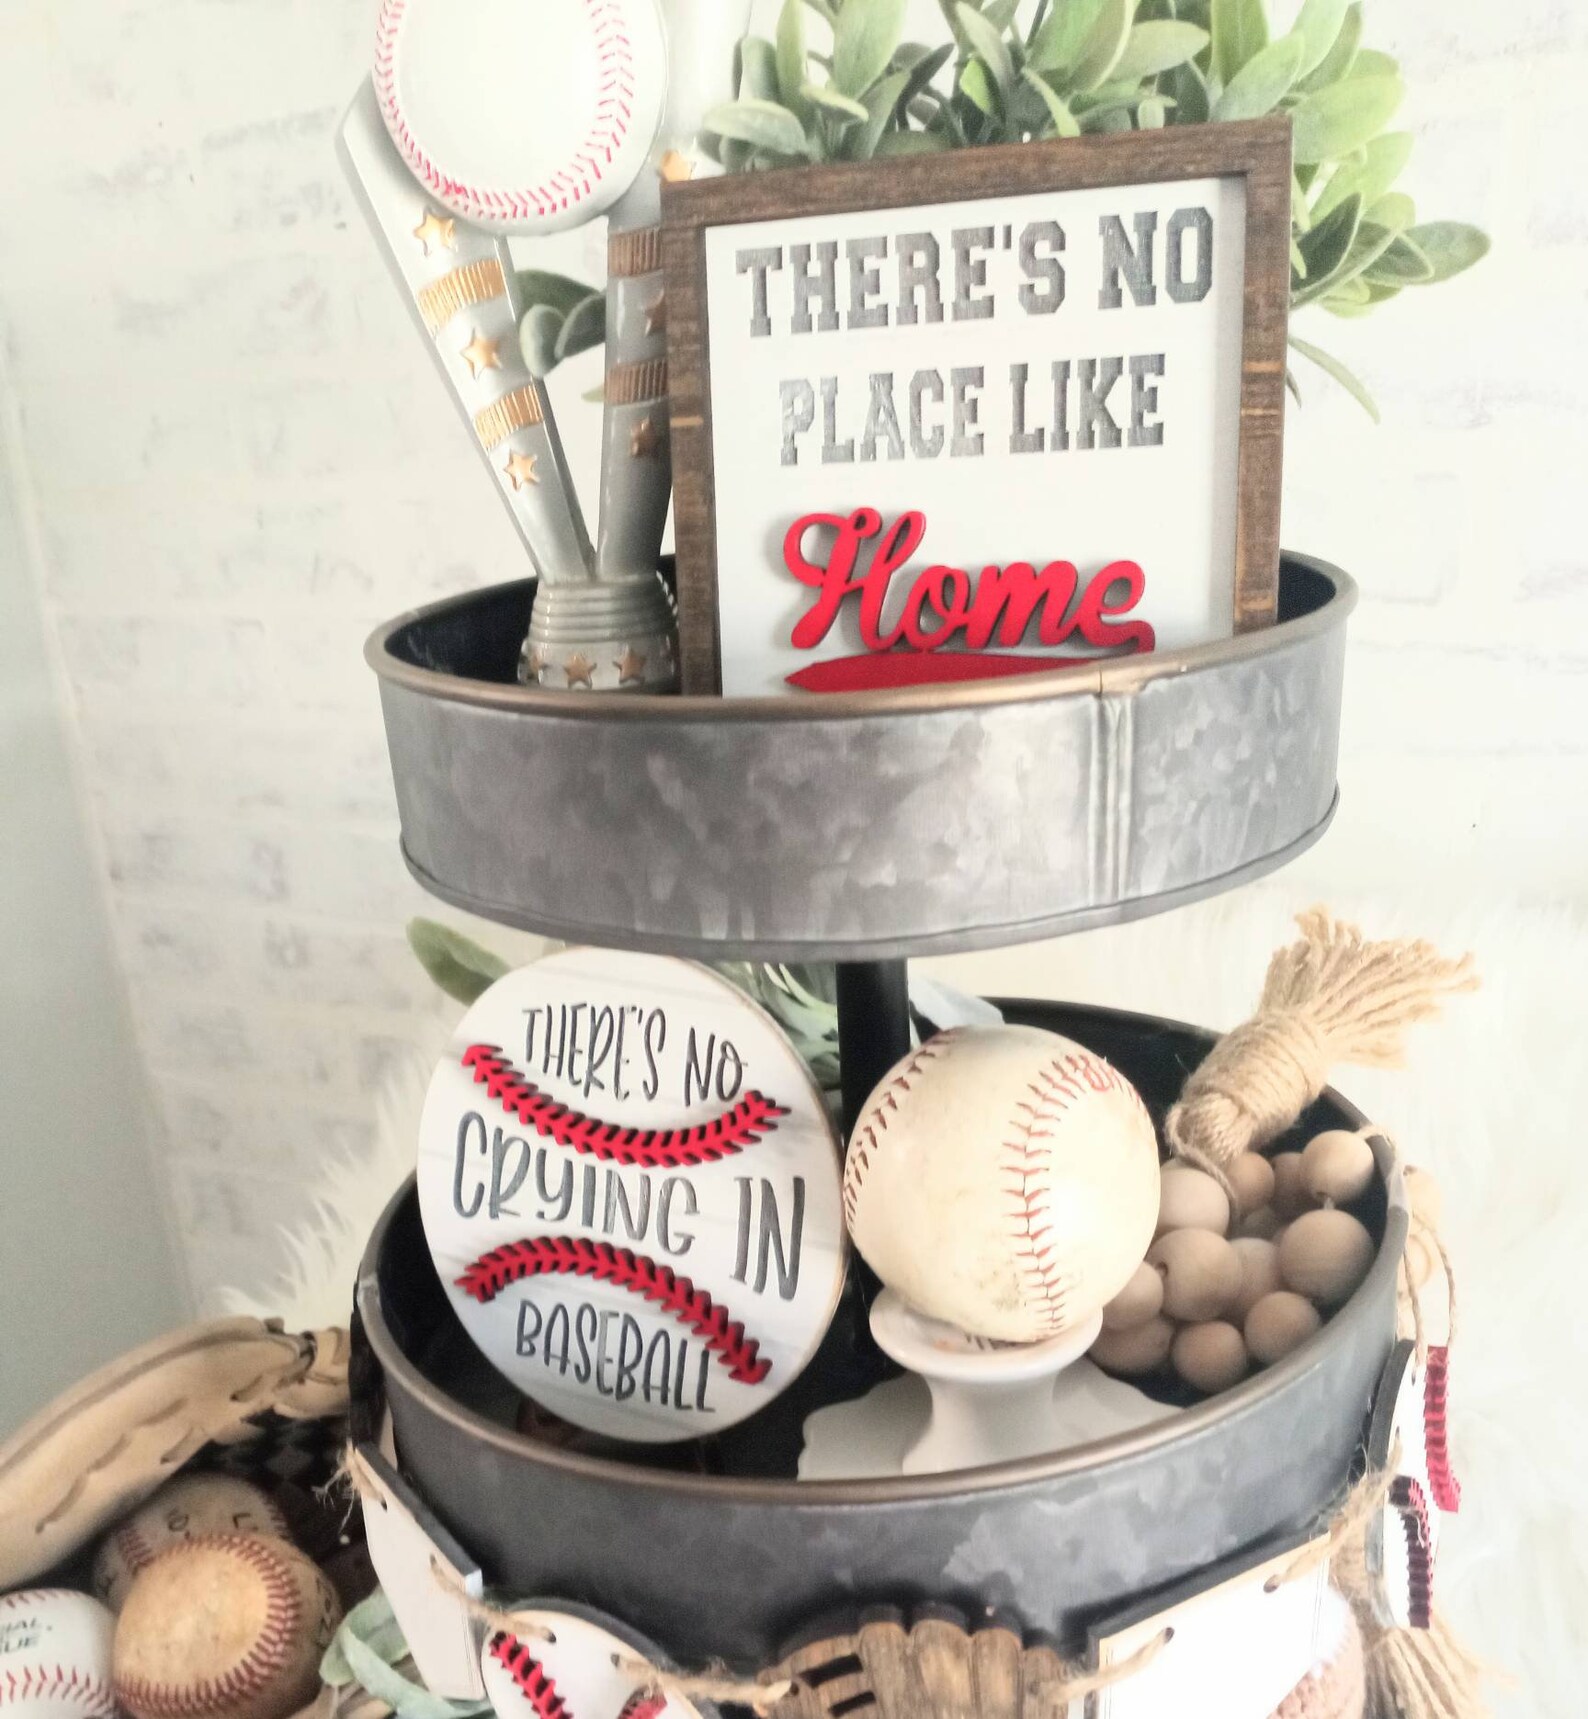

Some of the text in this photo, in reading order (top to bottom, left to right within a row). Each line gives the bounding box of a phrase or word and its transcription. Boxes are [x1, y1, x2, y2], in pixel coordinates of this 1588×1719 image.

[735, 207, 1214, 338] THERE'S NO
[778, 353, 1167, 467] PLACE LIKE
[783, 507, 1156, 652] Home
[521, 1002, 749, 1107] THERE'S NO
[452, 1111, 806, 1301] CRYING IN
[515, 1298, 716, 1414] BASEBALL
